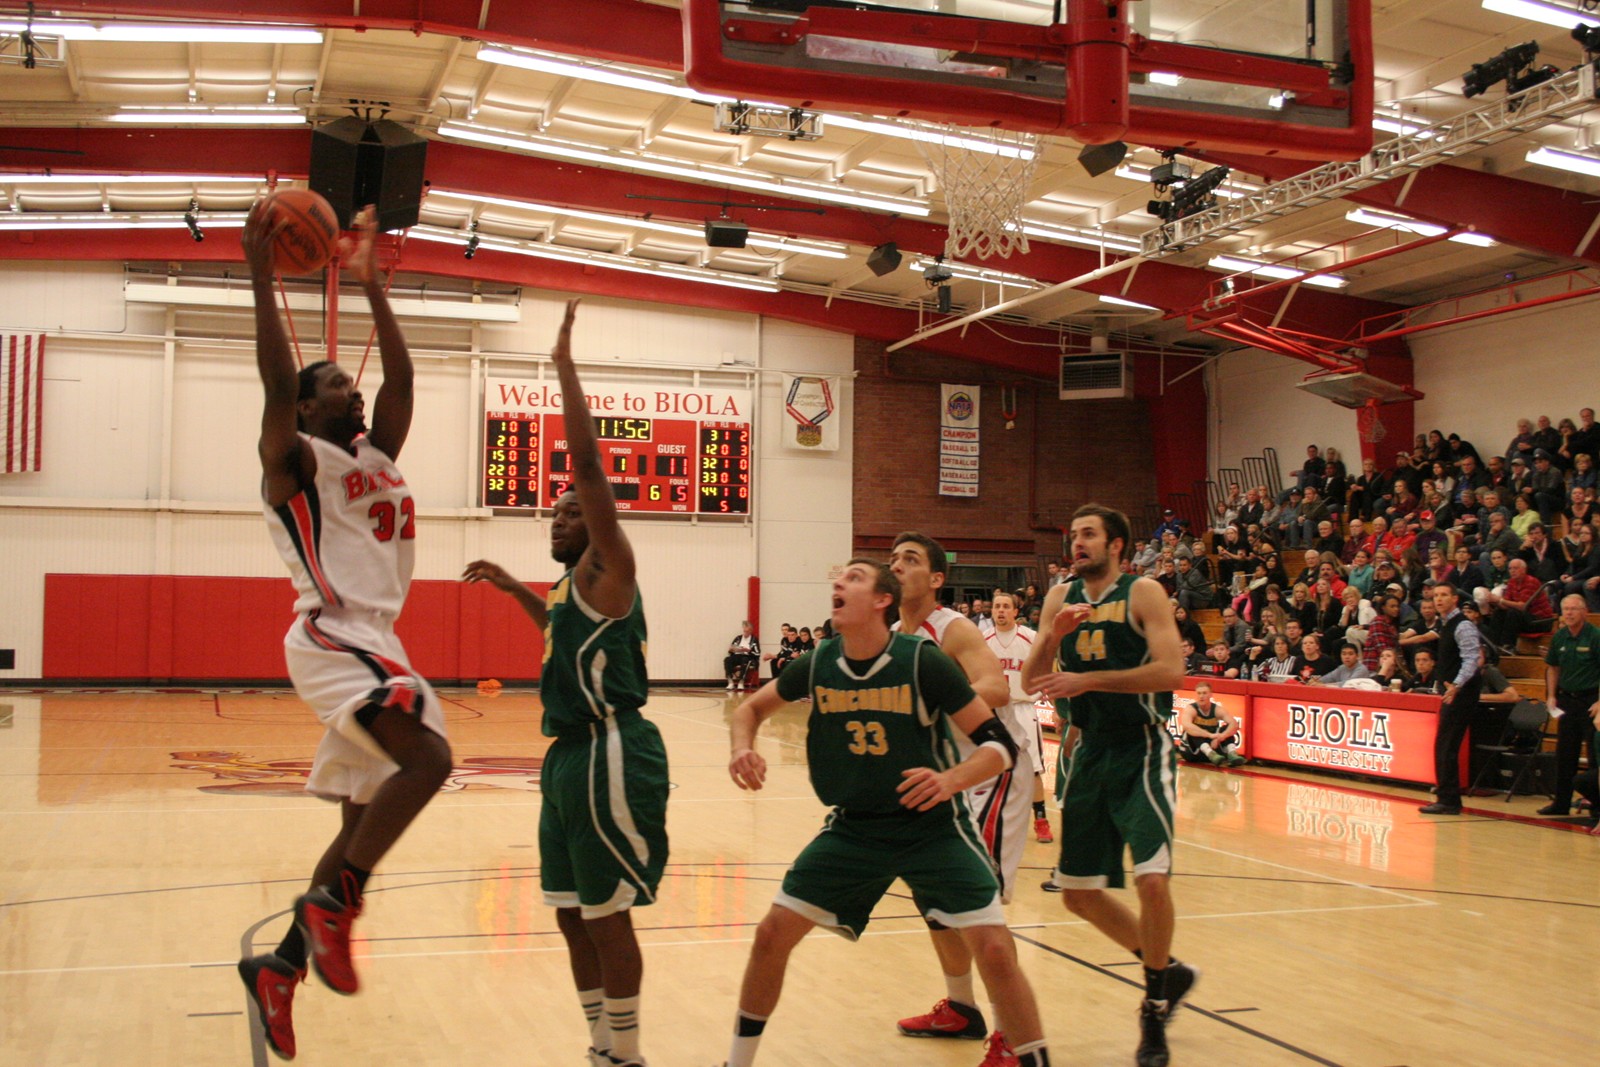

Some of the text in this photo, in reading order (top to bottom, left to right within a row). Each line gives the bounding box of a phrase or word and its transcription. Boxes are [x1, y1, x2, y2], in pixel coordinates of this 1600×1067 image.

[498, 384, 740, 416] Welcme to BIOLA
[509, 421, 518, 432] 0
[530, 422, 538, 433] 0
[601, 419, 649, 439] 11:52
[711, 430, 718, 441] 3
[740, 431, 748, 442] 2
[943, 429, 977, 439] CHAMPION
[497, 435, 538, 448] 2 0 0
[554, 440, 568, 450] HO
[943, 444, 969, 452] BASEBALL
[493, 450, 537, 462] 15 0 0
[609, 447, 632, 455] PERIOD
[657, 444, 687, 455] GUEST
[706, 444, 748, 456] 12 0 3
[621, 457, 627, 471] 1
[670, 457, 688, 475] 11
[703, 457, 717, 469] 32
[740, 459, 747, 470] 0
[942, 457, 969, 466] SOFTBALL
[488, 464, 537, 477] 22 0 2
[942, 471, 970, 480] BASEBALL
[625, 476, 640, 484] FOUL
[702, 471, 747, 484] 33 0 4
[489, 479, 537, 492] 32 0 0
[556, 482, 567, 497] 2
[650, 485, 660, 501] 6
[676, 485, 687, 502] 5
[701, 486, 717, 497] 44
[739, 487, 747, 499] 0
[508, 494, 517, 506] 2
[720, 500, 729, 512] 5
[368, 496, 416, 543] 32
[1076, 629, 1107, 661] 44
[1000, 658, 1024, 671] OLA
[815, 683, 913, 715] CONCORDIA
[1287, 704, 1393, 752] BIOLA
[845, 720, 890, 756] 33
[1288, 741, 1393, 774] UNIVERSITY
